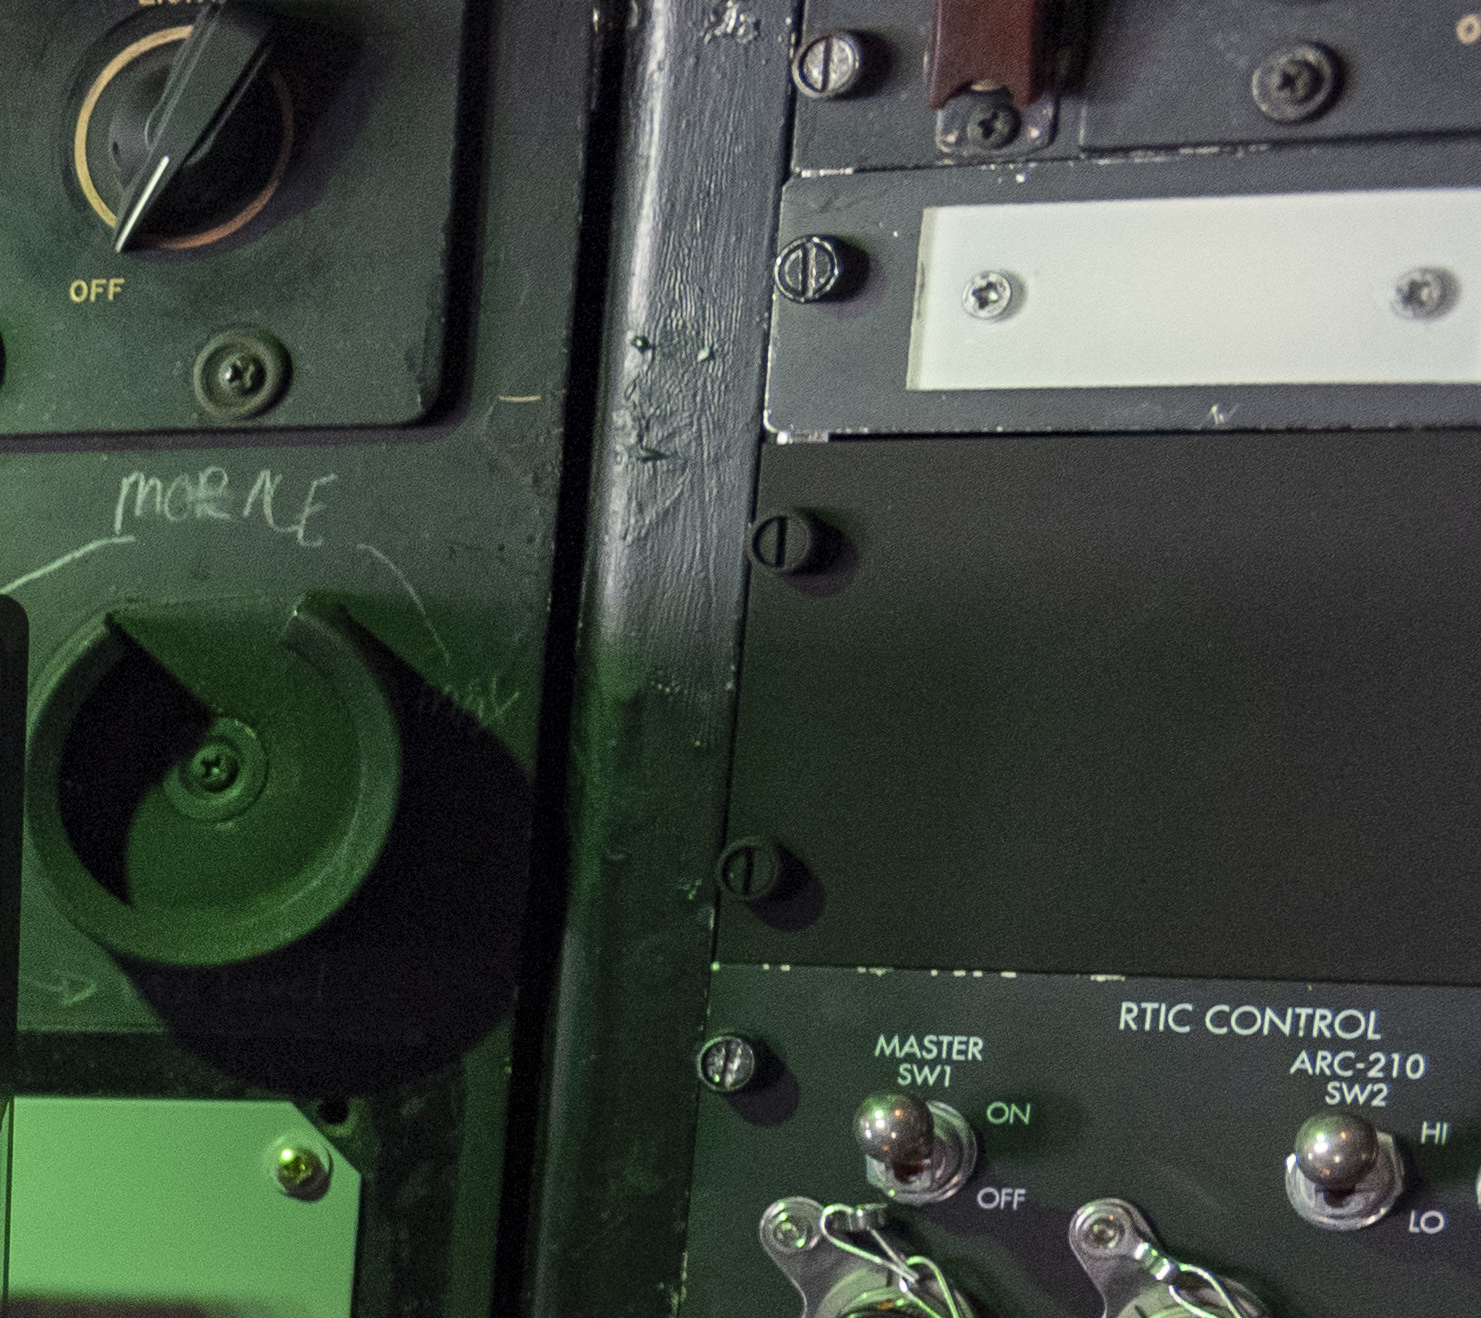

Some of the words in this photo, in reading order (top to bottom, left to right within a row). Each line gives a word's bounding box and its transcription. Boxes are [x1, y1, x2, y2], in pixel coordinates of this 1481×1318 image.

[69, 278, 124, 304] OFF
[1119, 1001, 1194, 1034] RTIC
[1205, 1003, 1383, 1041] CONTROL
[874, 1034, 985, 1062] MASTER
[896, 1063, 953, 1088] SW1
[1289, 1050, 1426, 1081] ARC-210
[1324, 1080, 1390, 1108] SW2
[986, 1101, 1032, 1125] ON
[1420, 1121, 1449, 1146] HI
[977, 1187, 1027, 1211] OFF
[1408, 1210, 1445, 1235] LO
